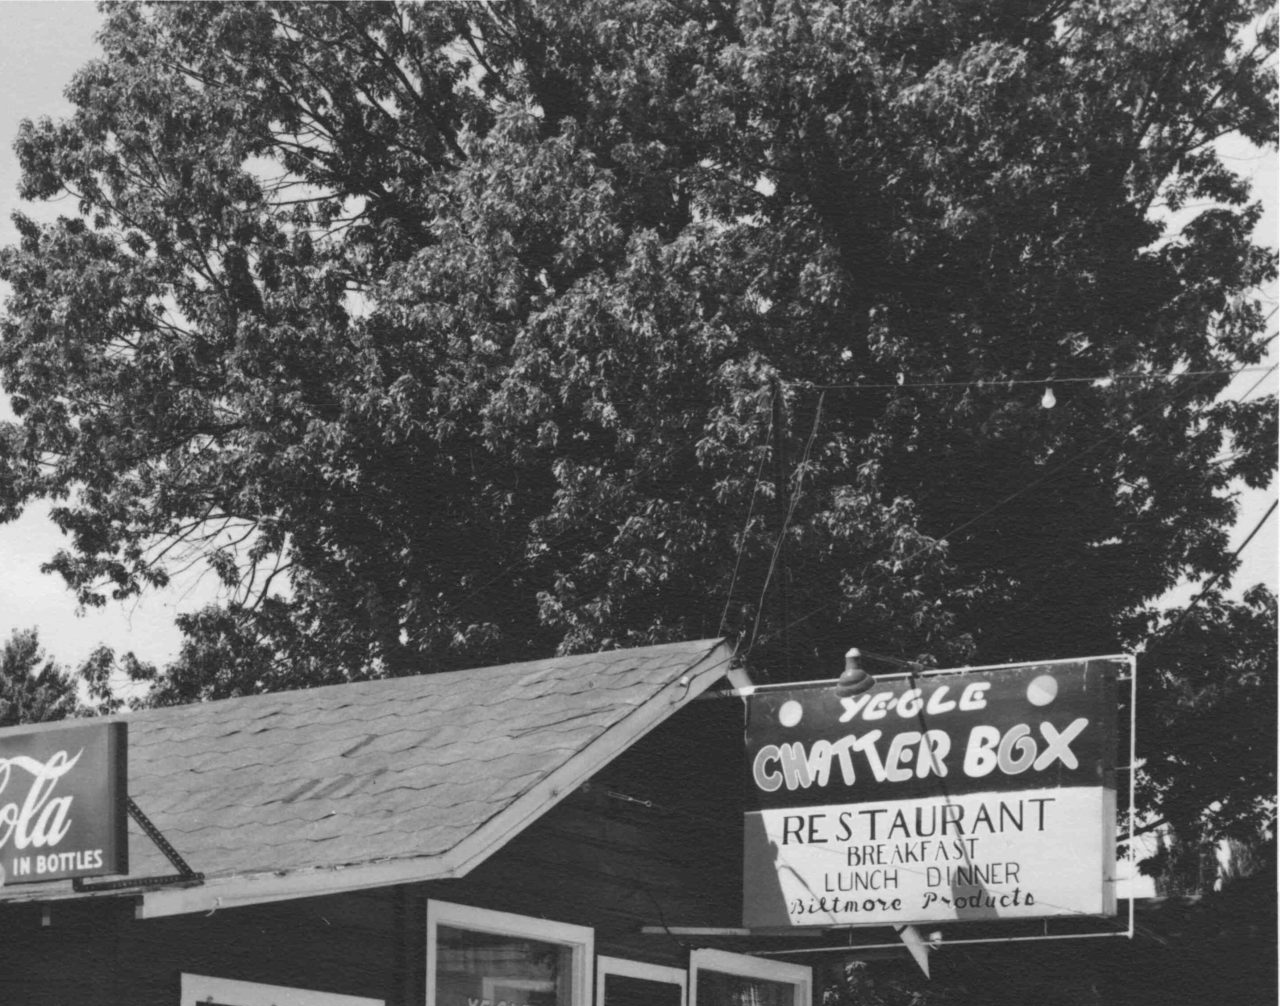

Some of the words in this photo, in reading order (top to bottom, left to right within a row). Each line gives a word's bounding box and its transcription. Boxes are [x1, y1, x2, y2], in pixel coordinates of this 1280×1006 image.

[753, 729, 951, 792] CHATTER
[782, 798, 1056, 845] RESTAURANT
[13, 857, 30, 876] IN
[36, 849, 103, 874] BOTTLES
[847, 838, 979, 867] BREAKFAST
[825, 869, 898, 892] LUNCH
[926, 863, 1020, 888] DINNER
[790, 896, 902, 915] Biltmore
[922, 887, 1035, 911] Products
